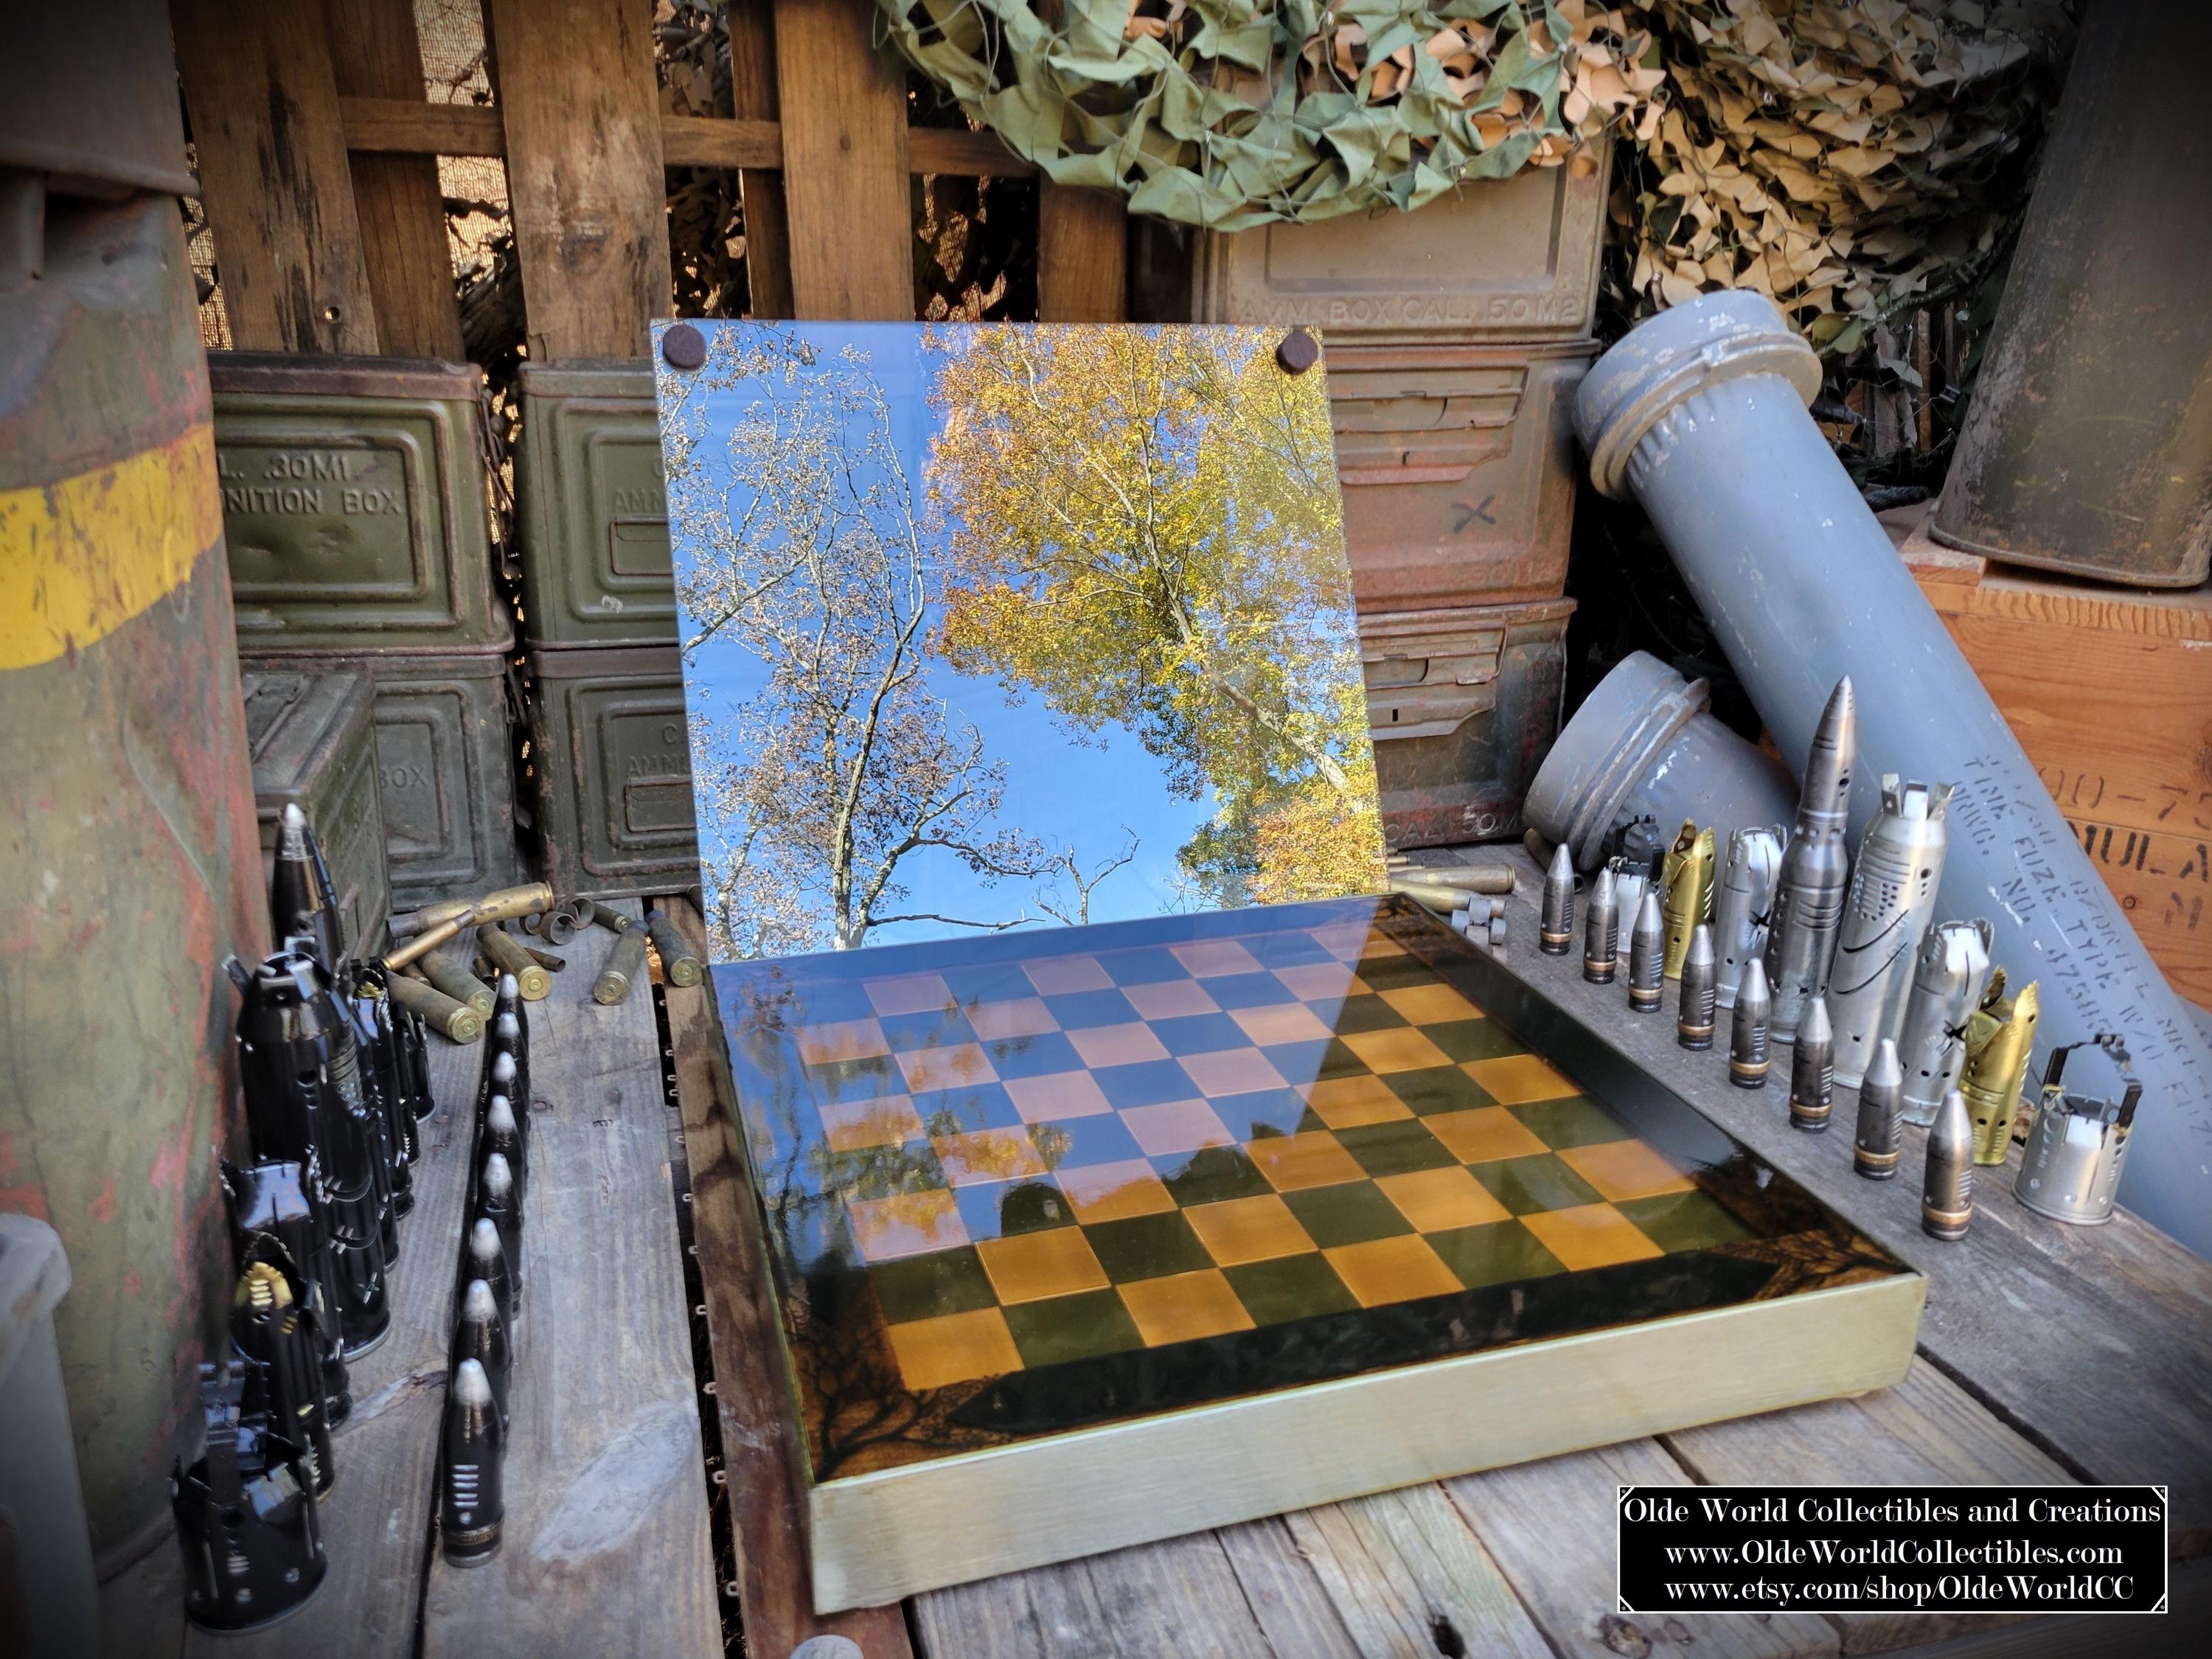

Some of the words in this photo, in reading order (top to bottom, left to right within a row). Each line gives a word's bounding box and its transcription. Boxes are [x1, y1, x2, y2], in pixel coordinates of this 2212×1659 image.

[1329, 298, 1392, 324] BOX
[341, 487, 403, 515] BOX
[2065, 920, 2121, 990] TYPE
